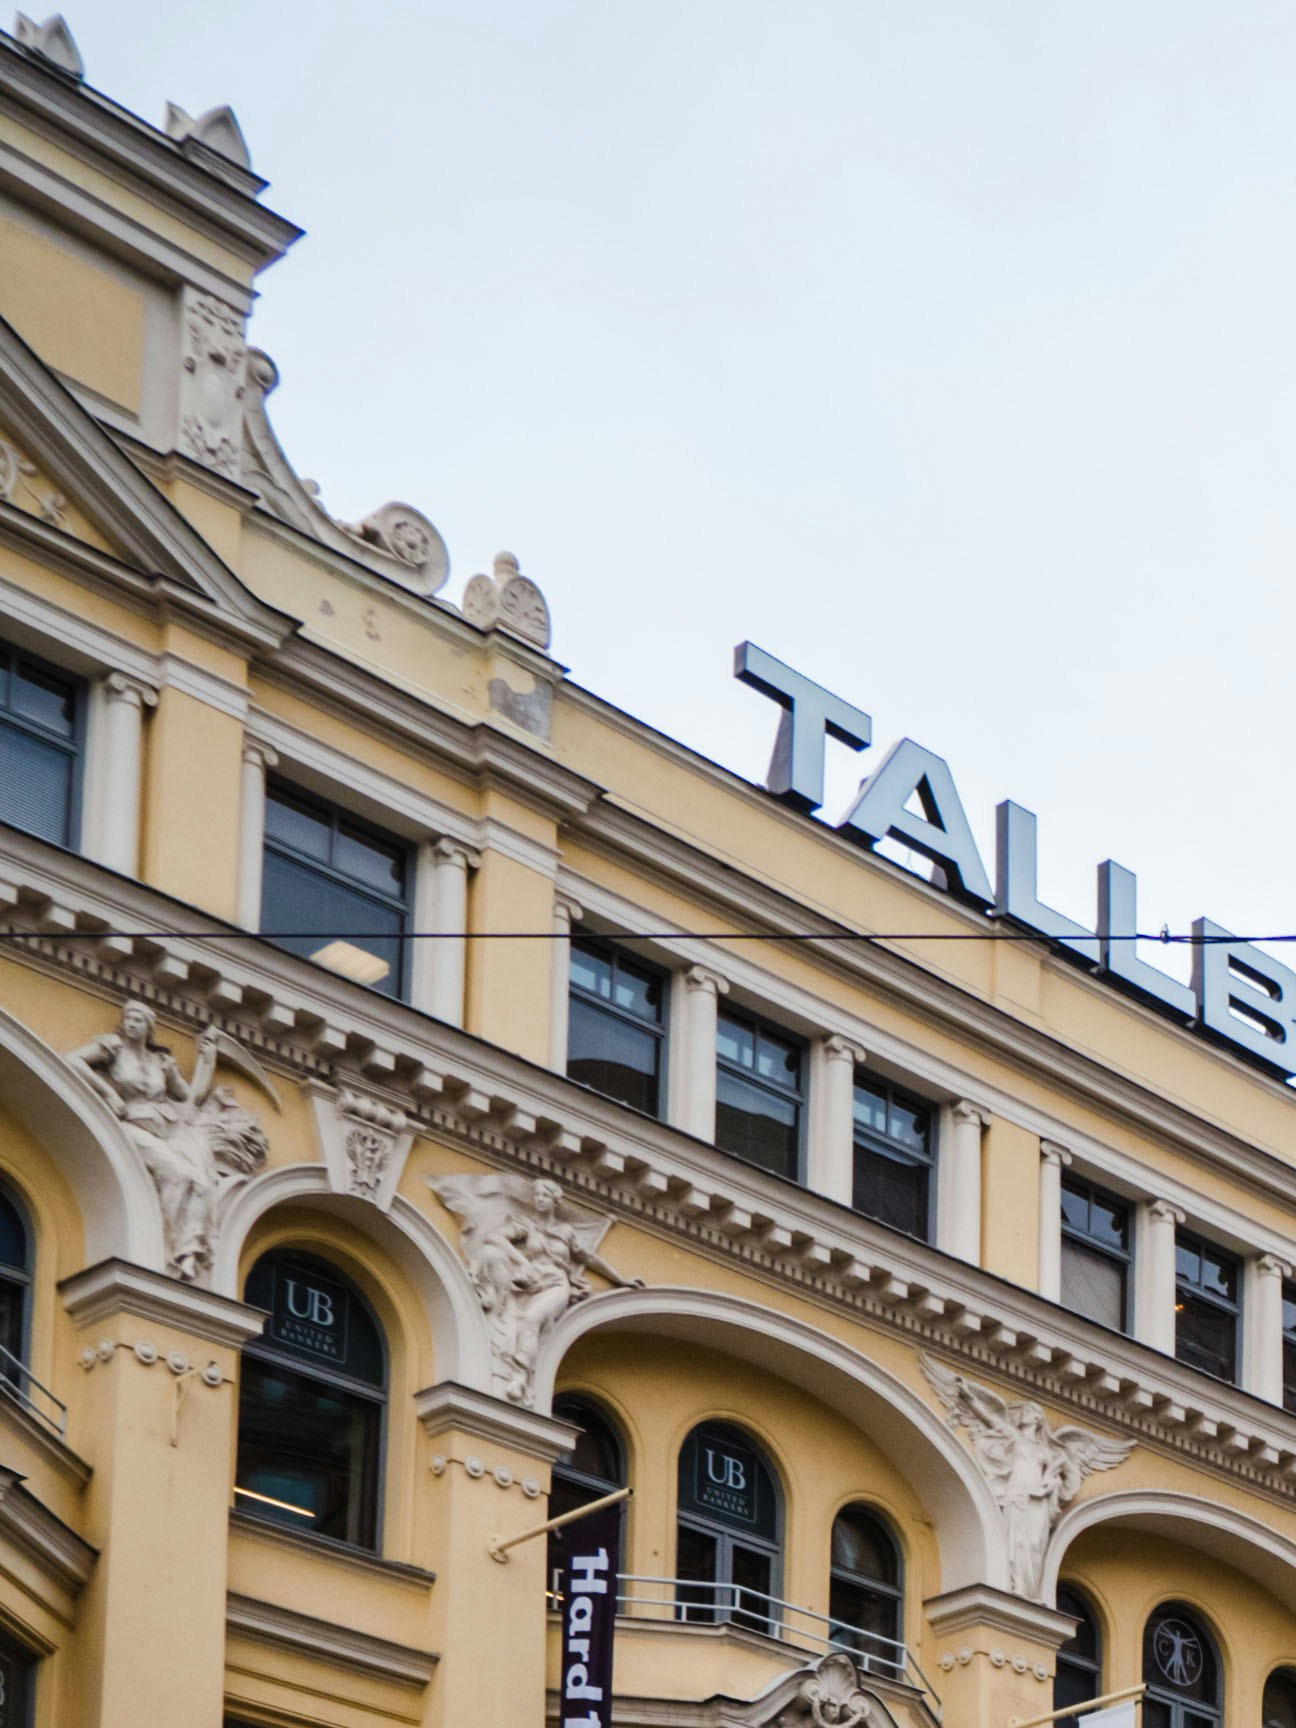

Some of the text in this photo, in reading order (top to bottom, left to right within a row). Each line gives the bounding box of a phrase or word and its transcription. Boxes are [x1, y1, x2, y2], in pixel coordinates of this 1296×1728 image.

[284, 1278, 335, 1327] UB
[705, 1448, 746, 1490] UB
[566, 1547, 609, 1701] Hard
